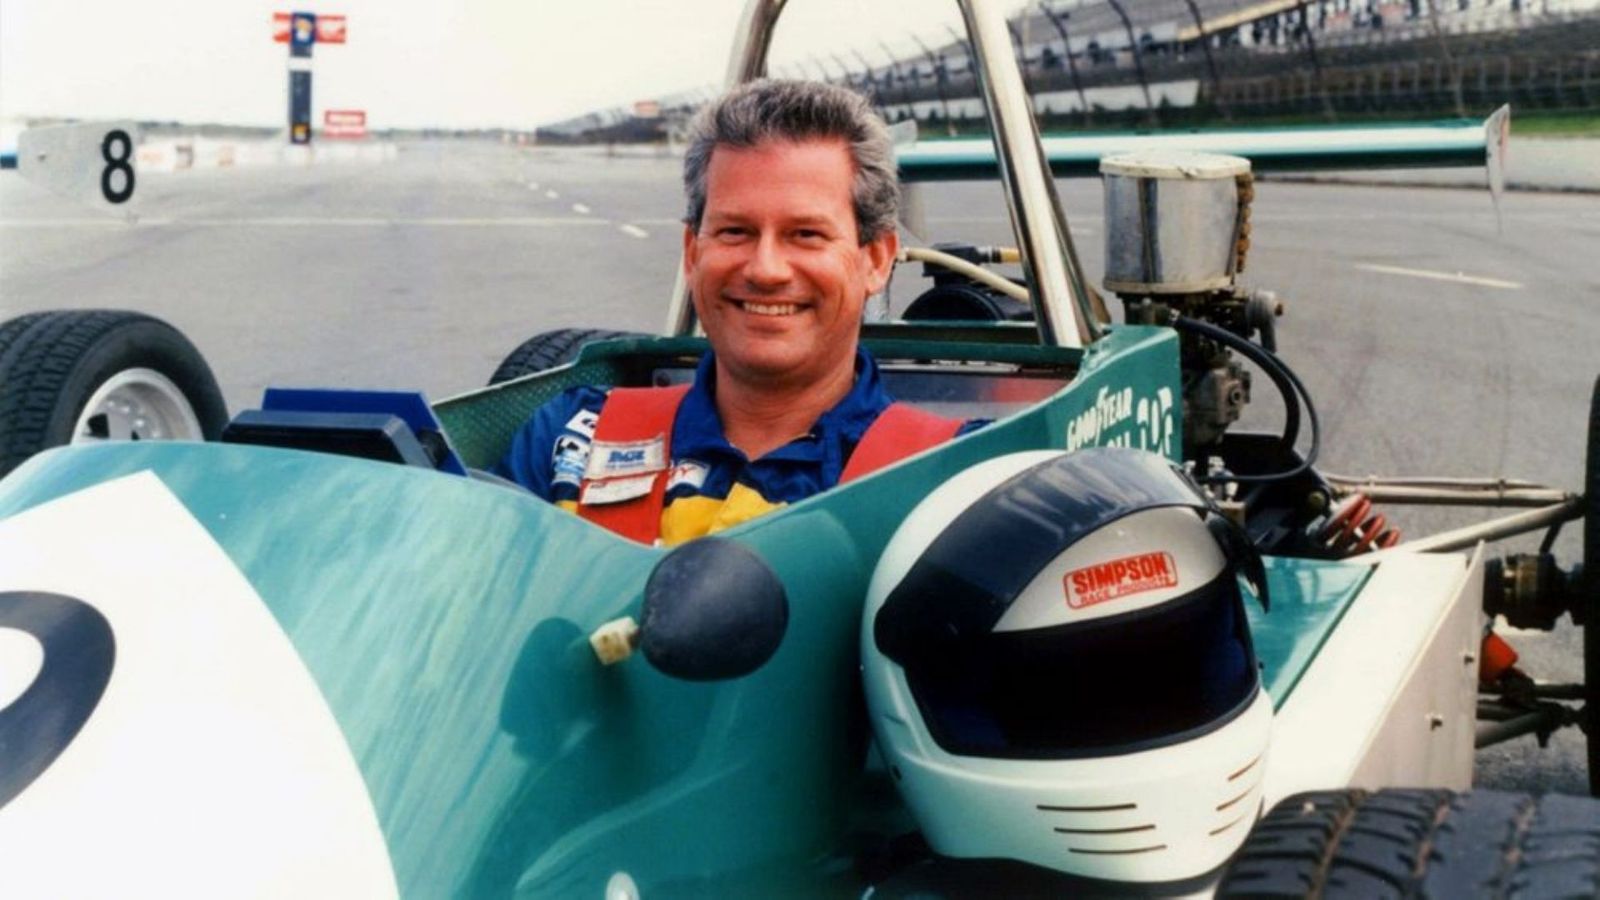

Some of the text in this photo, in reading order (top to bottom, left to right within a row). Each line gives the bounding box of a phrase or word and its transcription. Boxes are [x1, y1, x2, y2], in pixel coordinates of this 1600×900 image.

[101, 129, 136, 204] 8
[1066, 386, 1133, 454] GOODYEAR
[1071, 552, 1169, 595] SIMPSON
